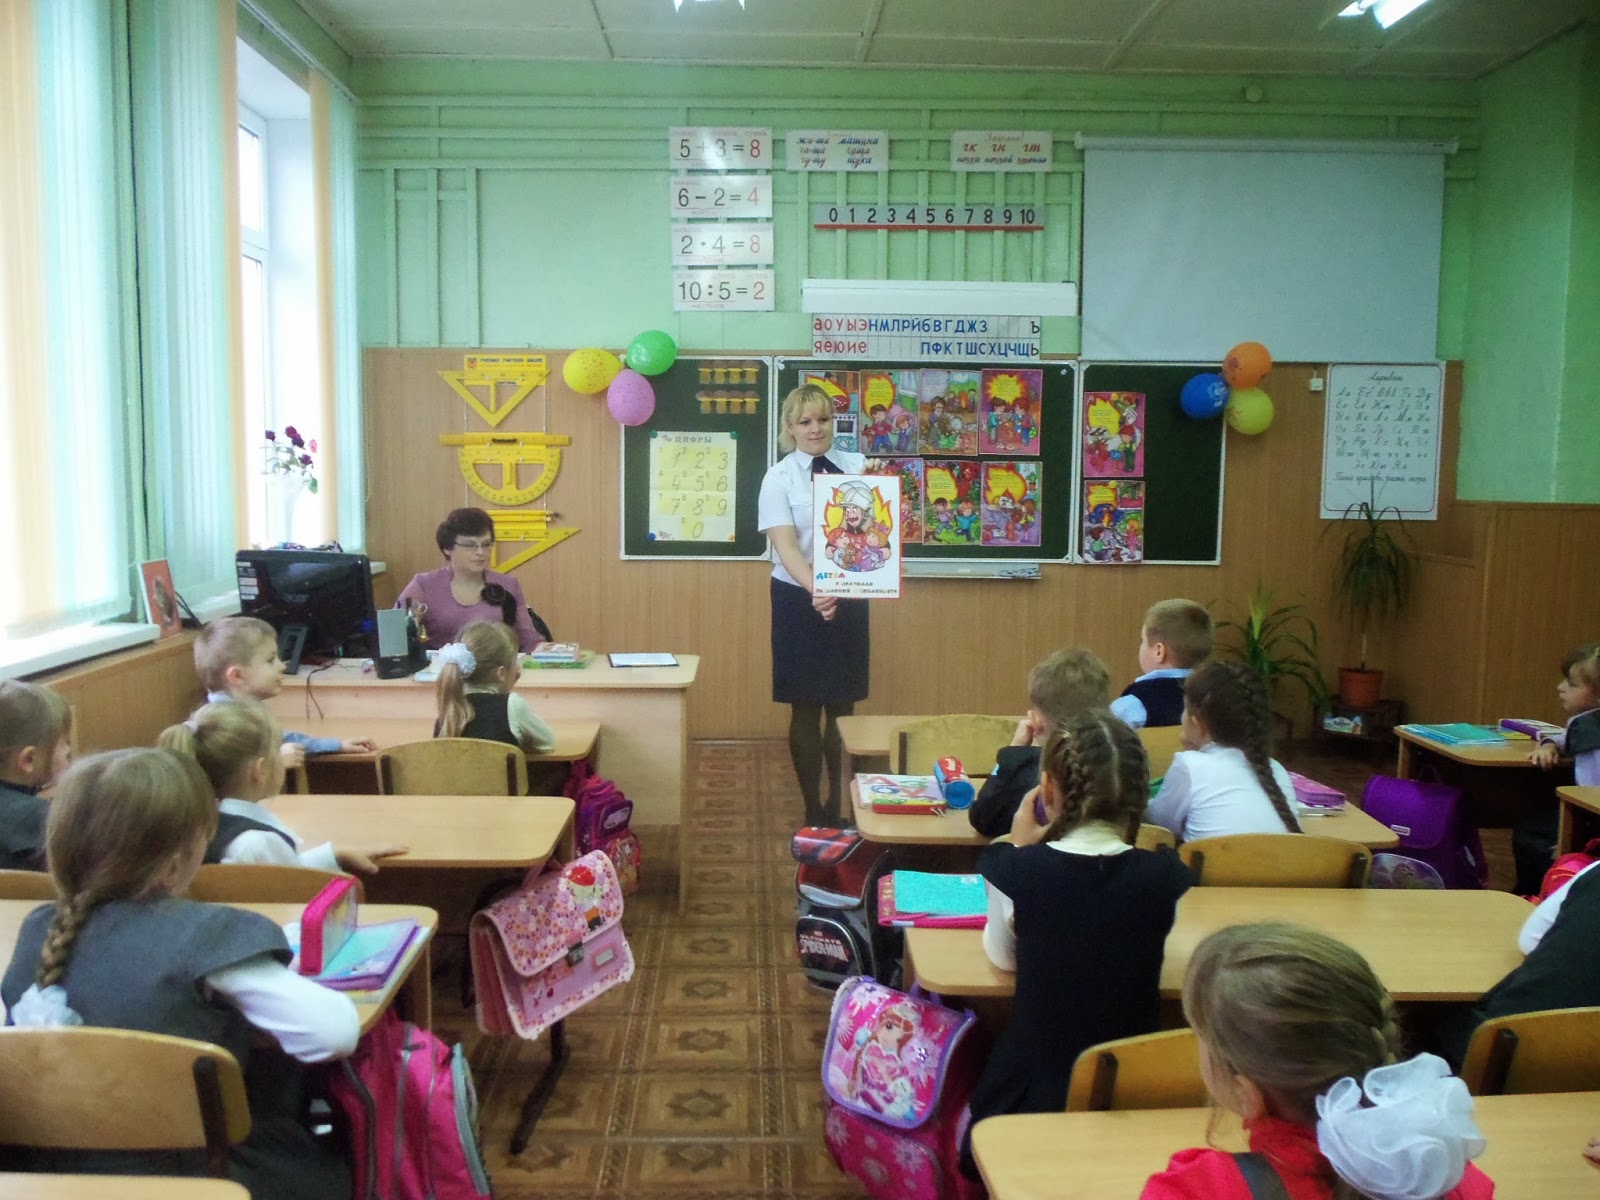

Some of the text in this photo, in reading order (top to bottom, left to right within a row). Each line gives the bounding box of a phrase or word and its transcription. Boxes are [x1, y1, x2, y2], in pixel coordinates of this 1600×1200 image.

[680, 138, 691, 158] 5
[715, 138, 727, 158] 3
[750, 138, 761, 158] 8
[678, 187, 690, 207] 6
[714, 187, 726, 207] 2
[747, 186, 760, 207] 4
[828, 207, 1035, 224] 0 1 2 3 4 5 6 7 8 9 10
[681, 234, 693, 254] 2
[712, 234, 726, 254] 4
[750, 234, 761, 254] 8
[678, 281, 701, 300] 10
[718, 281, 731, 300] 5
[753, 281, 765, 300] 2
[694, 451, 705, 469] 2
[718, 452, 728, 470] 3
[694, 475, 705, 492] 5
[717, 475, 728, 492] 6
[672, 498, 728, 516] 7 8 9
[692, 521, 704, 539] 0
